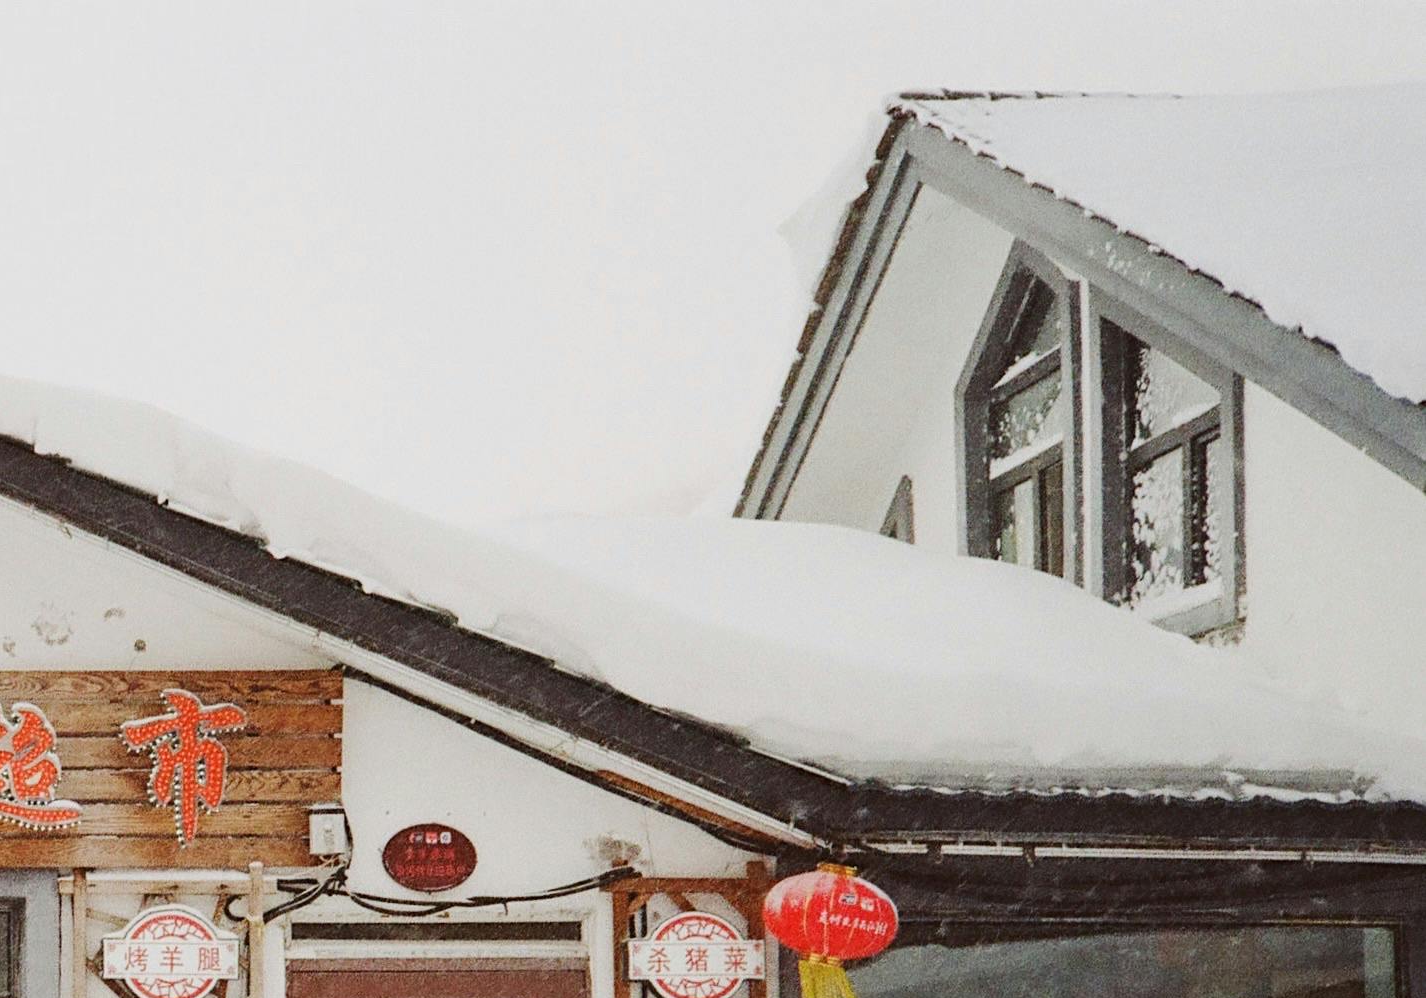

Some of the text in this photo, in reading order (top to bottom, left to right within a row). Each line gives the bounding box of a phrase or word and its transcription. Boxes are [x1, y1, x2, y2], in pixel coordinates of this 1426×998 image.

[125, 946, 222, 973] 烤羊腿
[647, 947, 748, 973] 杀猪菜
